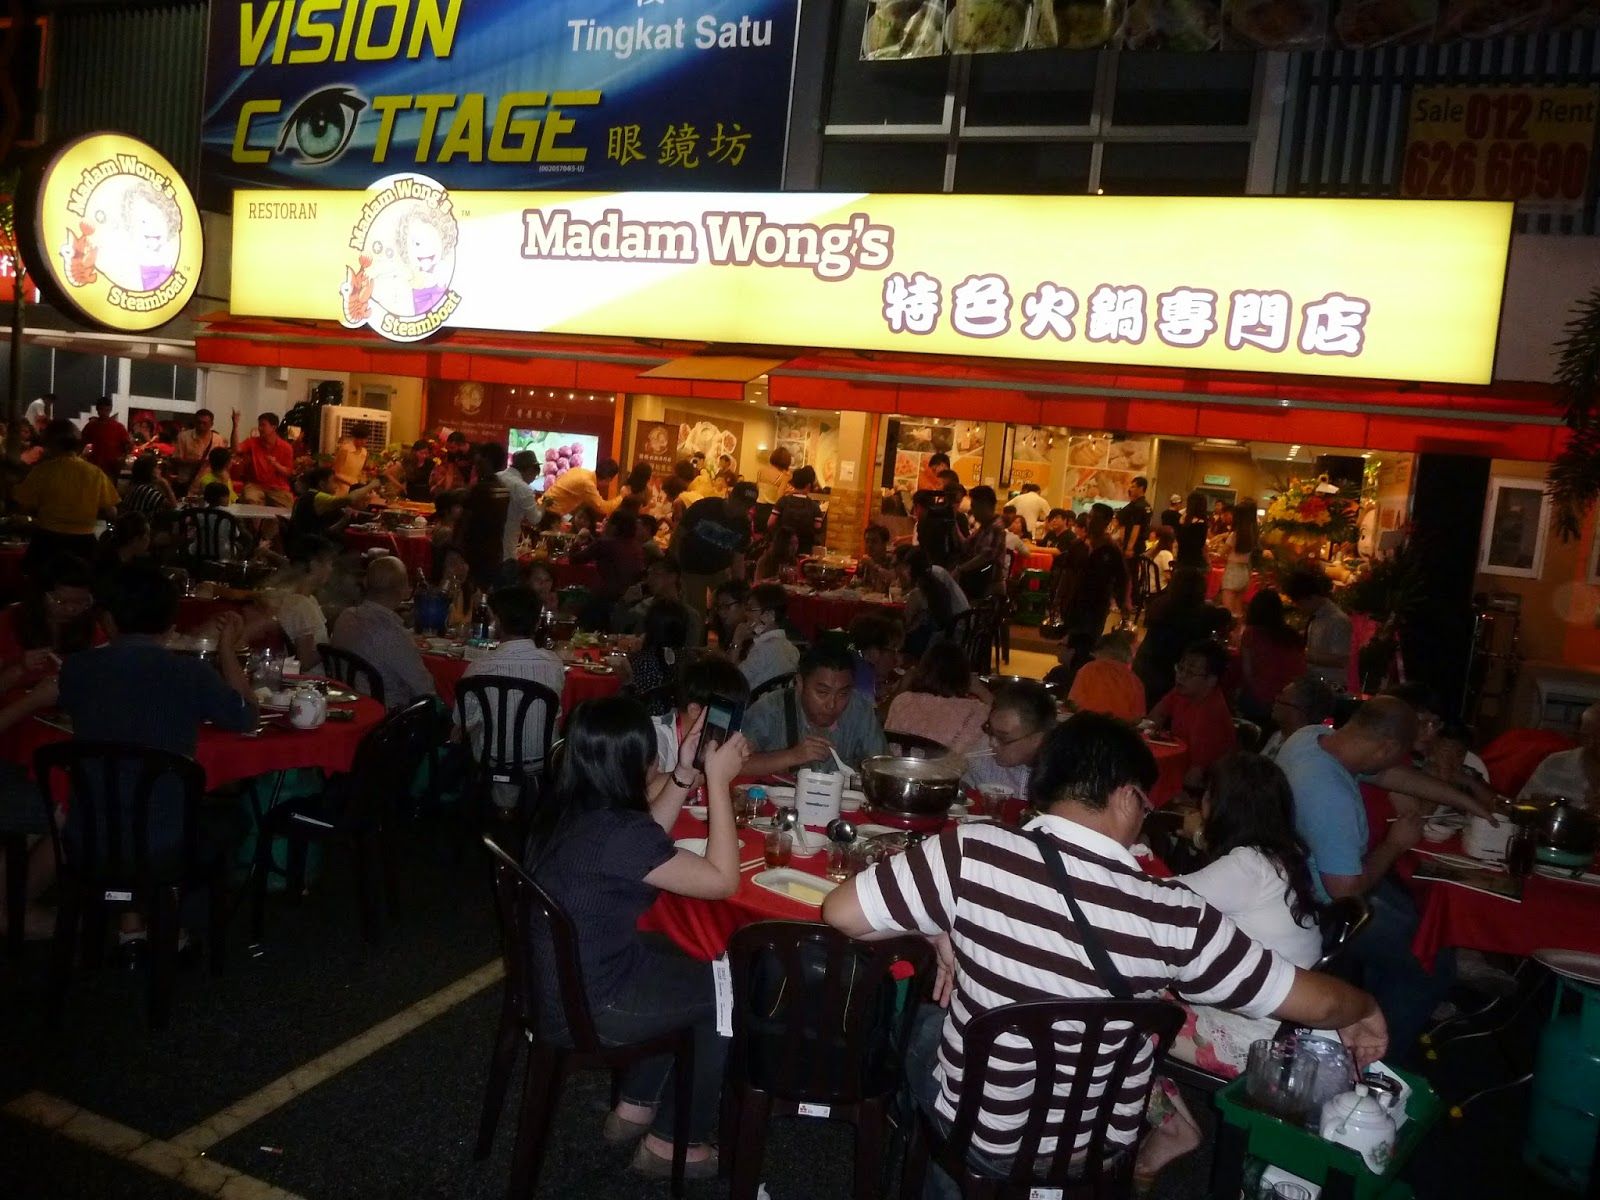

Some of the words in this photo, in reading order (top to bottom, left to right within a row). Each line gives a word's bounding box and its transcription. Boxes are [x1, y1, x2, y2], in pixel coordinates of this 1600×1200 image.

[239, 0, 462, 67] VISION
[567, 17, 686, 60] Tingkat
[694, 14, 773, 50] Satu
[1415, 97, 1465, 123] Sale
[1464, 93, 1533, 140] 012
[1536, 97, 1594, 123] Rent
[606, 122, 753, 169] 眼鏡坊
[66, 159, 120, 218] Madam
[116, 153, 177, 201] Wong's
[1404, 140, 1478, 196] 626
[1484, 140, 1588, 199] 6690
[248, 202, 318, 220] RESTORAN
[349, 188, 397, 251] Madam
[394, 178, 454, 215] Wong's
[521, 208, 699, 264] Madam
[702, 211, 895, 282] Wong's
[107, 270, 188, 313] Steamboat
[381, 290, 462, 338] Steamboat
[882, 271, 1371, 358] 特色火鍋專門店
